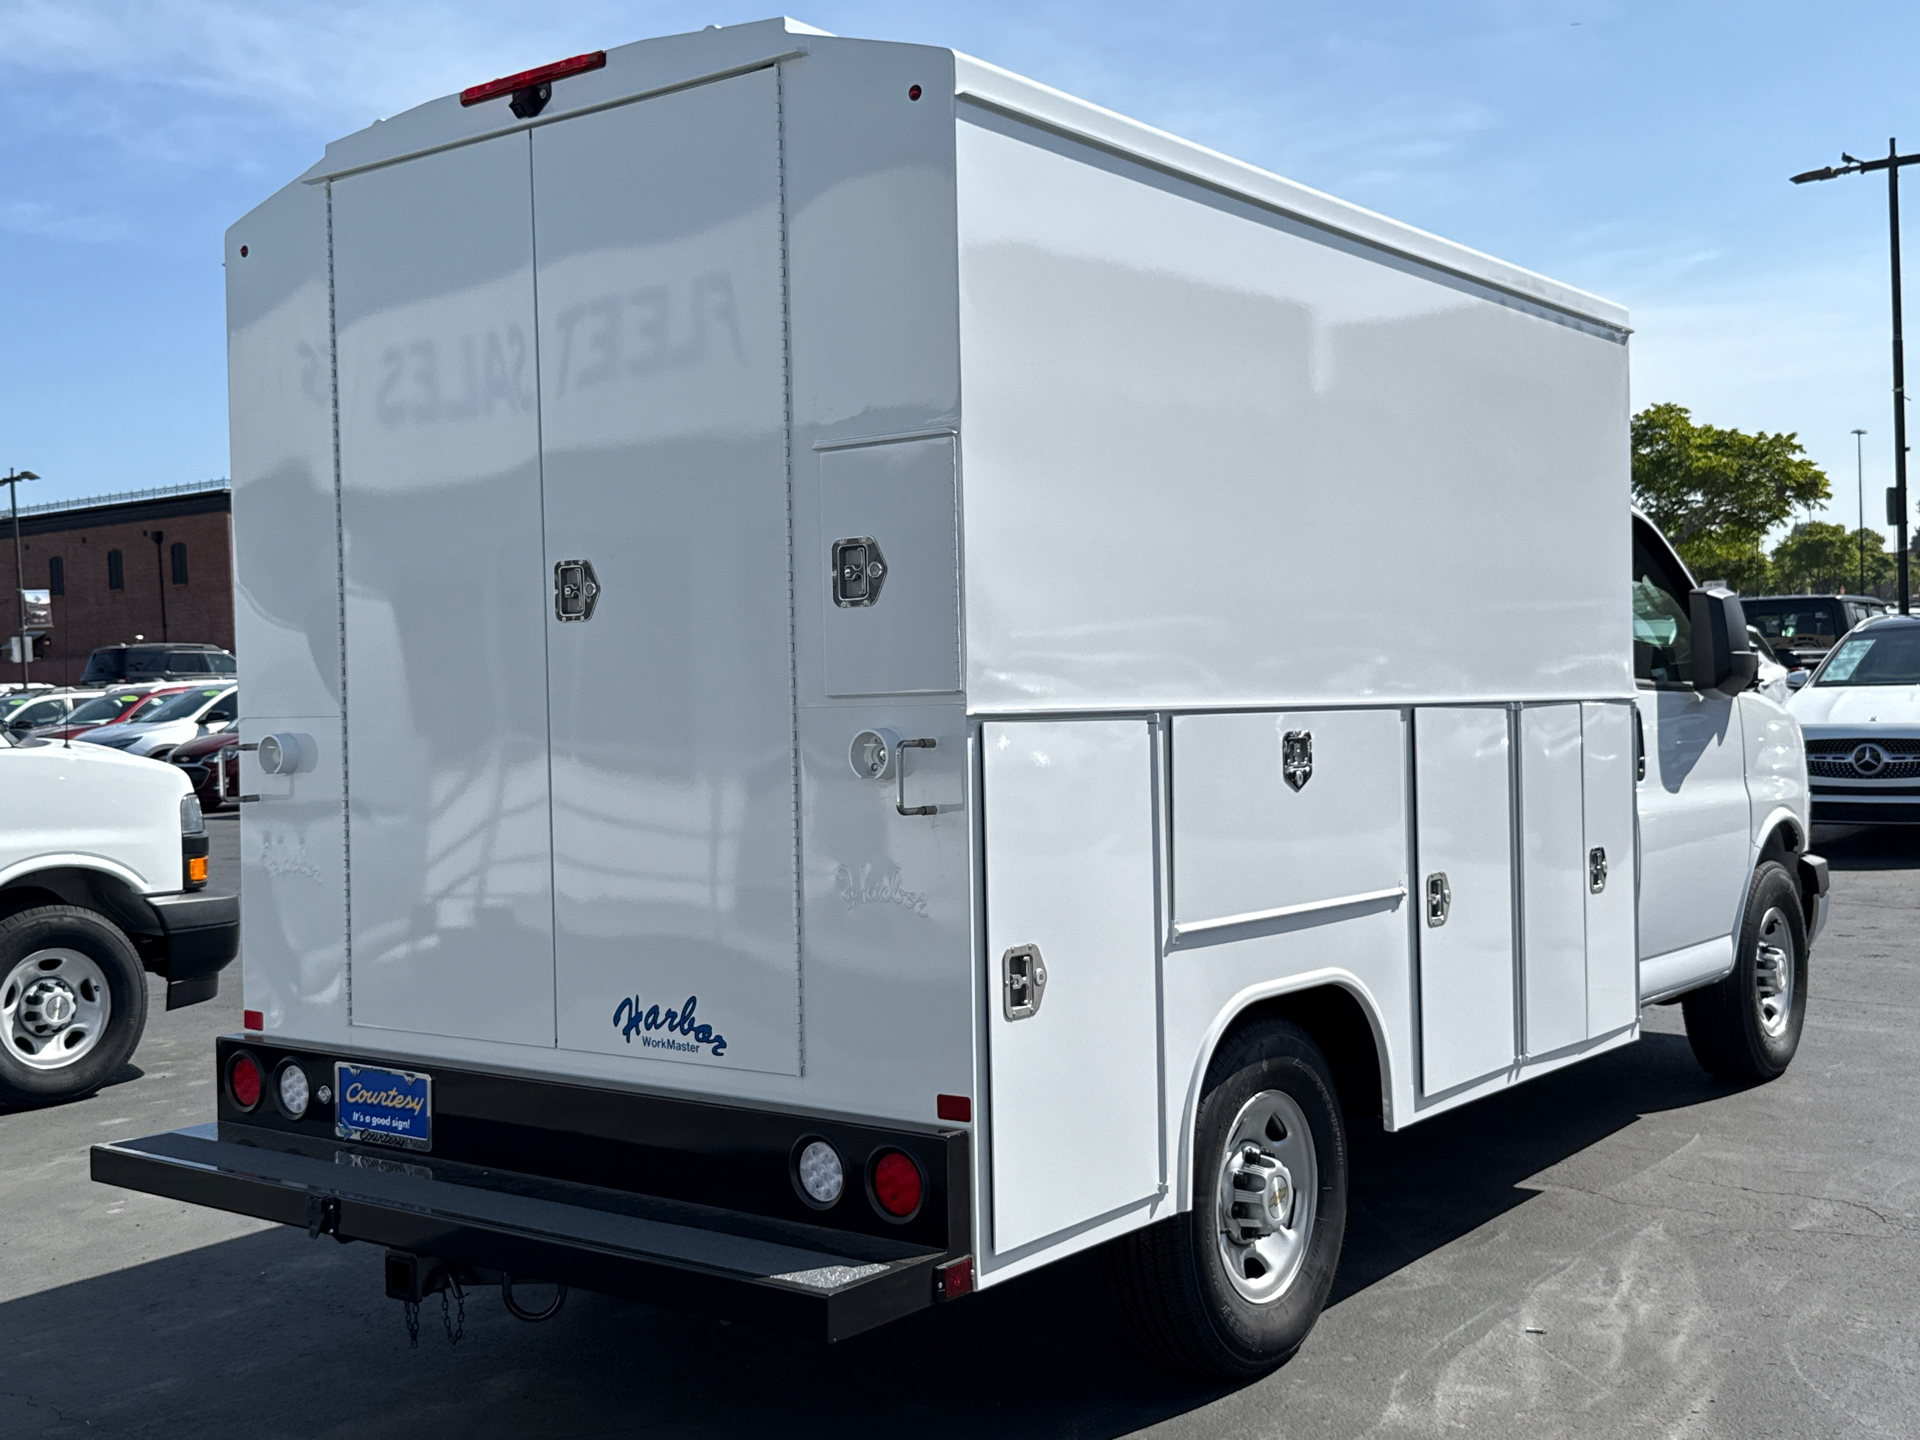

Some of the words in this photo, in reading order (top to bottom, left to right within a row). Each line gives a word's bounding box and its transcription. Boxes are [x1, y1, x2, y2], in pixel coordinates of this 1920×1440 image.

[613, 994, 727, 1056] Harbor
[642, 1036, 700, 1053] WorkMaster
[346, 1082, 424, 1116] Courtesy
[352, 1111, 364, 1123] It's
[365, 1115, 371, 1123] a
[371, 1115, 391, 1127] good
[391, 1117, 411, 1131] sign!
